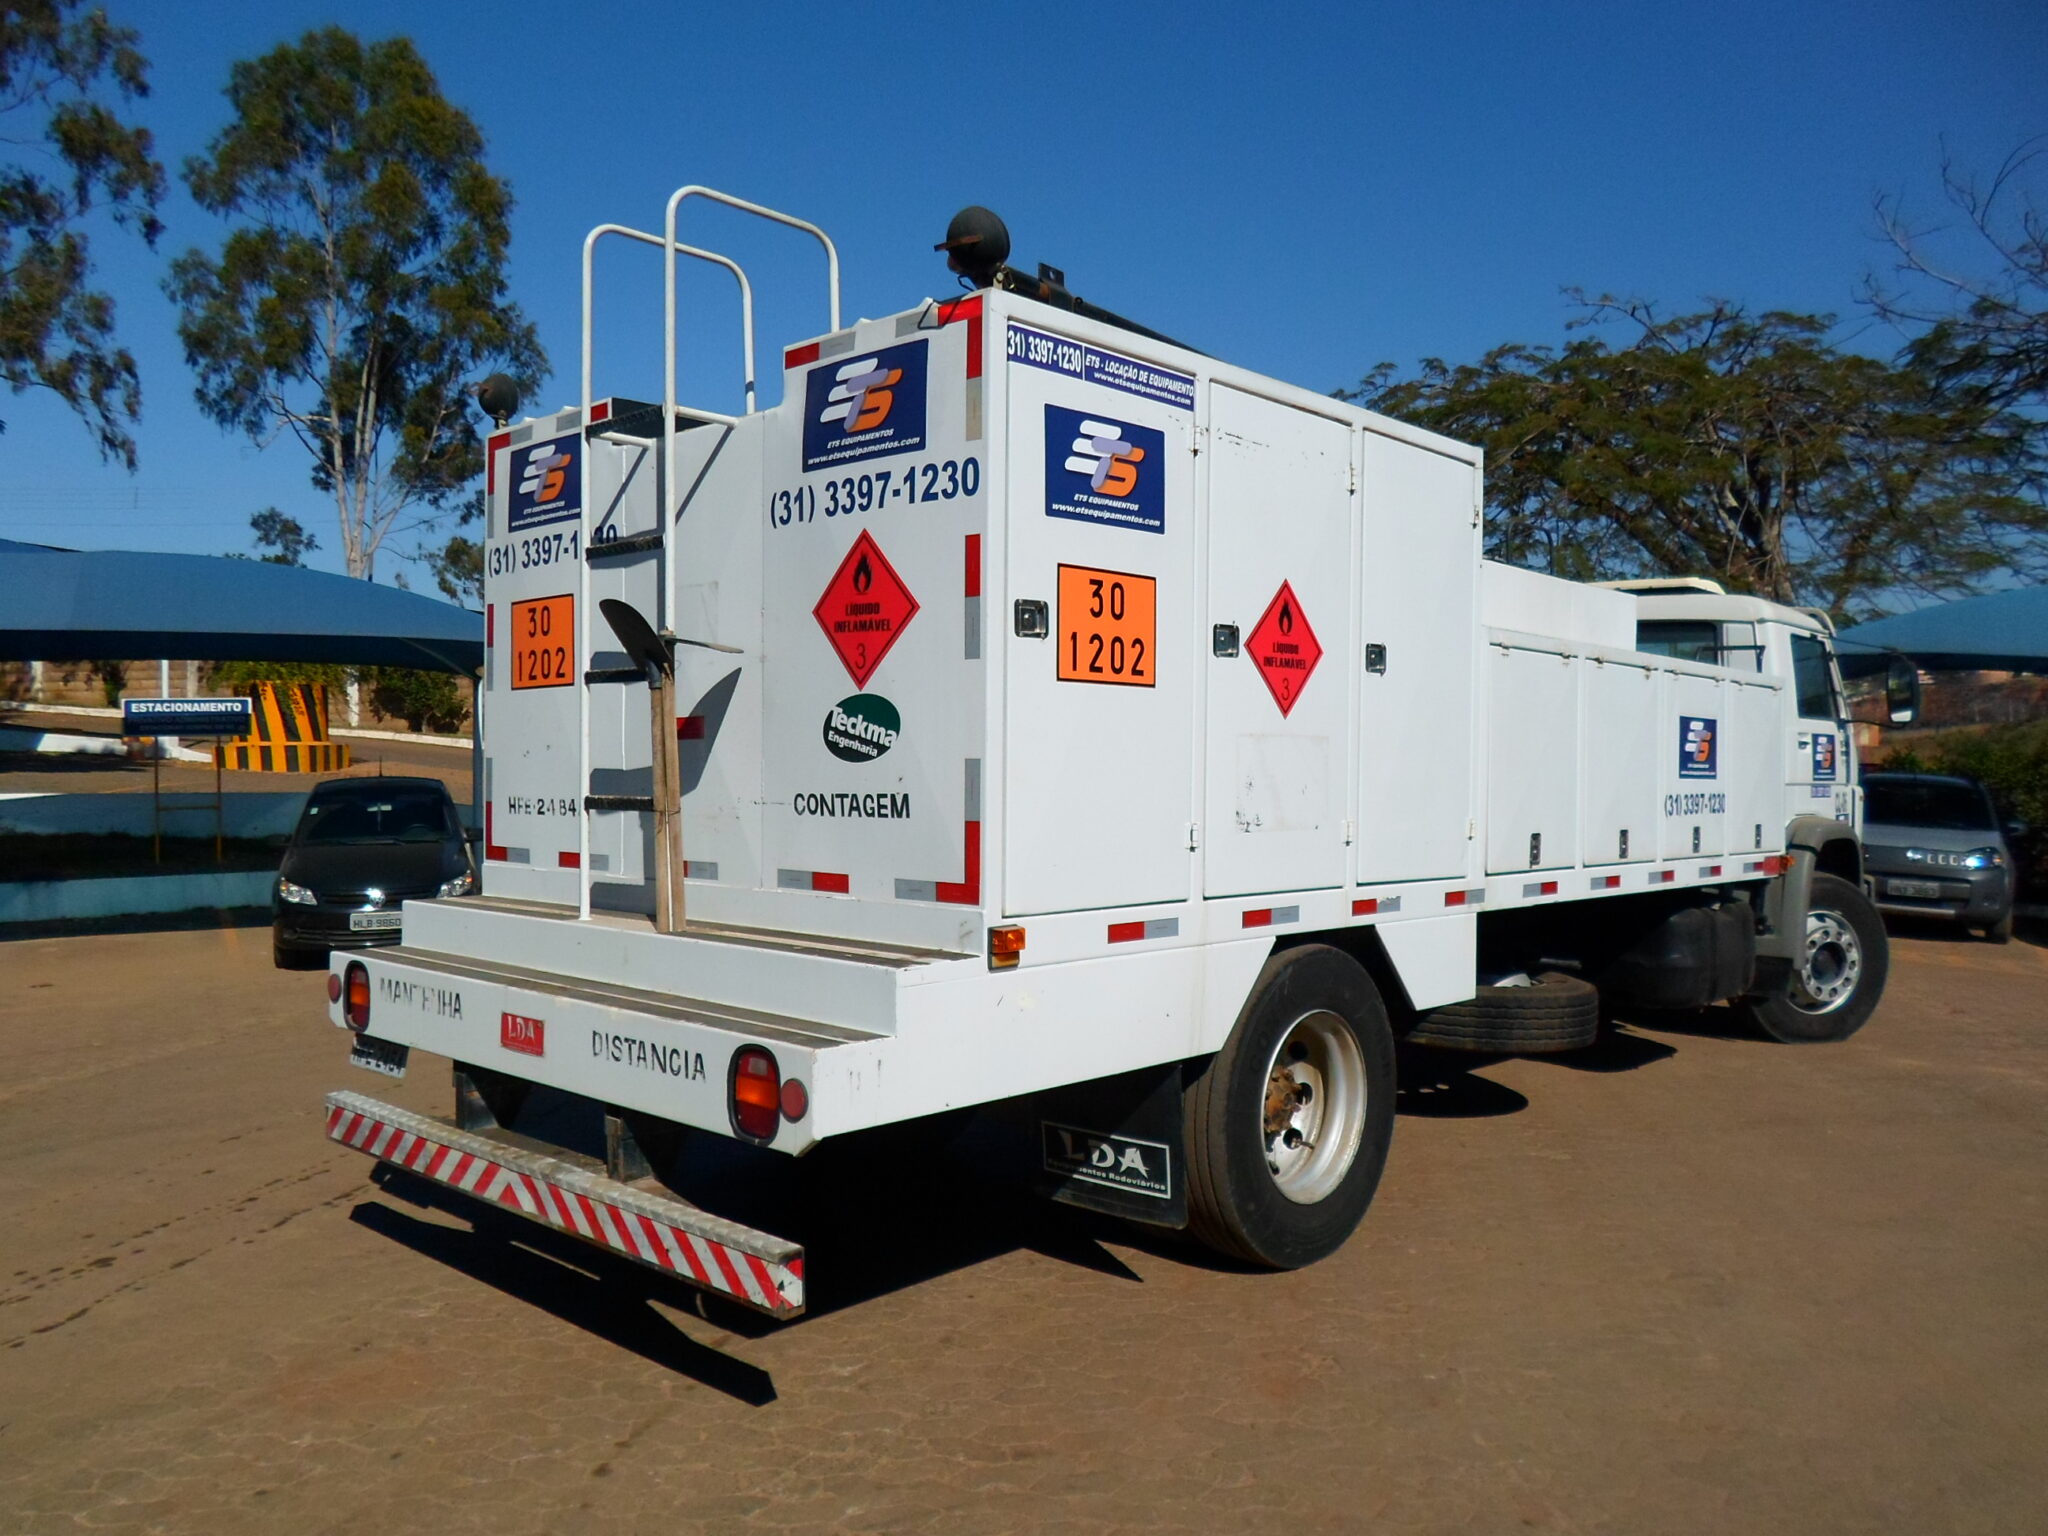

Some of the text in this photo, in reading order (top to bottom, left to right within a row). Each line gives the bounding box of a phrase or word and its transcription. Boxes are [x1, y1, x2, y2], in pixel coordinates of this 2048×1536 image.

[1028, 335, 1081, 373] 3397-1230
[1085, 354, 1100, 369] ETS
[1104, 359, 1138, 380] LOCAÇÃO
[1138, 370, 1148, 383] DE
[1093, 371, 1191, 405] www.etsequipamentos.com
[807, 437, 920, 465] www.etsequipamentos.com
[827, 428, 894, 449] ETS EQUIPAMENTOS
[770, 456, 980, 529] (31) 3397-1230
[1073, 493, 1140, 511] ETS EQUIPAMENTOS
[1052, 503, 1161, 527] www.etsequipamentos.com
[488, 543, 516, 579] (31)
[1088, 578, 1125, 621] 30
[527, 605, 551, 638] 30
[834, 617, 892, 633] INFLAMÁVEL
[518, 647, 566, 682] 1202
[854, 642, 866, 670] 3
[1070, 631, 1145, 677] 1202
[1281, 677, 1290, 701] 3
[131, 702, 242, 713] ESTACIONAMENTO
[830, 705, 898, 748] Teckma
[827, 730, 878, 757] Engenharia
[793, 792, 911, 819] CONTAGEM
[1664, 792, 1726, 818] (31) 3397-1230
[507, 1014, 535, 1041] LDA
[591, 1029, 707, 1083] DISTANCIA
[1057, 1129, 1150, 1179] LDA
